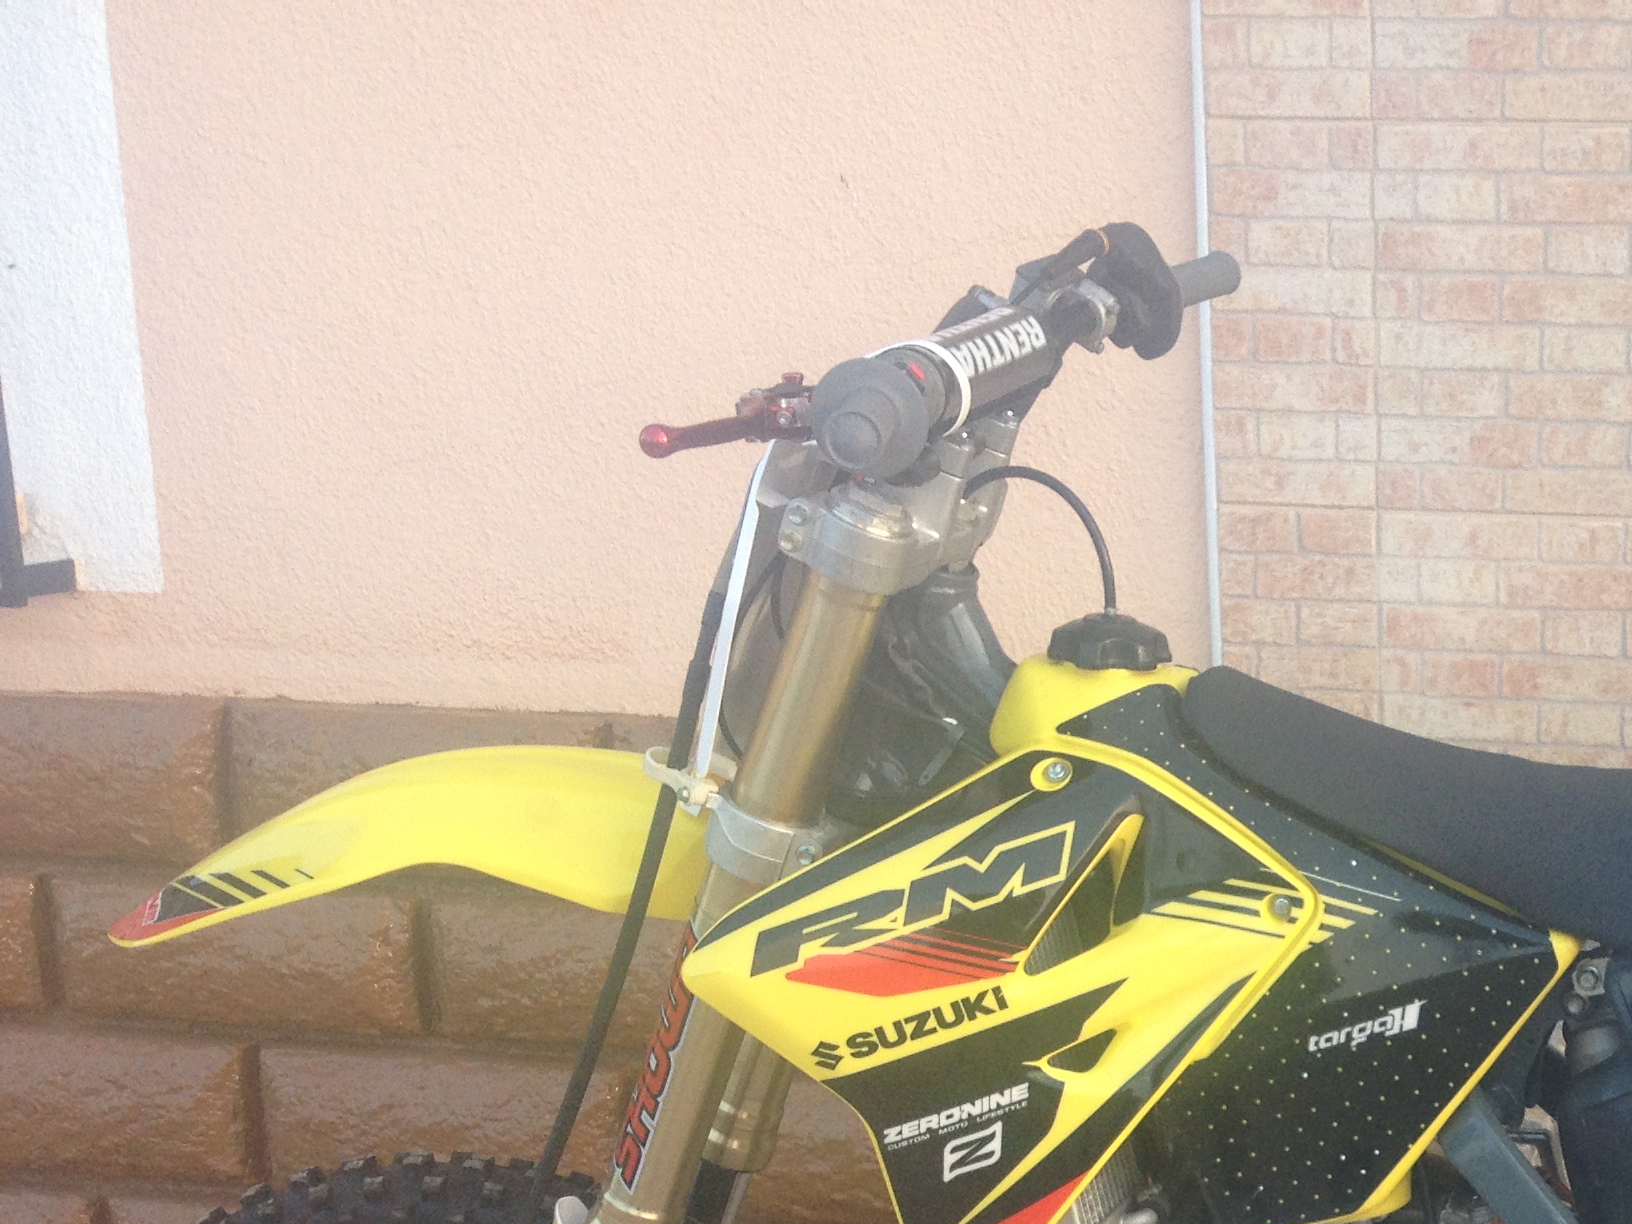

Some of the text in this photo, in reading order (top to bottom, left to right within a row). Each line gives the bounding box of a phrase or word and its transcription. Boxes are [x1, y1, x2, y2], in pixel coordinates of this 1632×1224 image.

[948, 314, 1047, 379] RENTHA
[750, 821, 1075, 977] RM
[845, 985, 1009, 1060] SUZUKI
[883, 1082, 1030, 1145] ZERONINE
[887, 1100, 1029, 1151] CUSTOM MOTO LIFESTYLE
